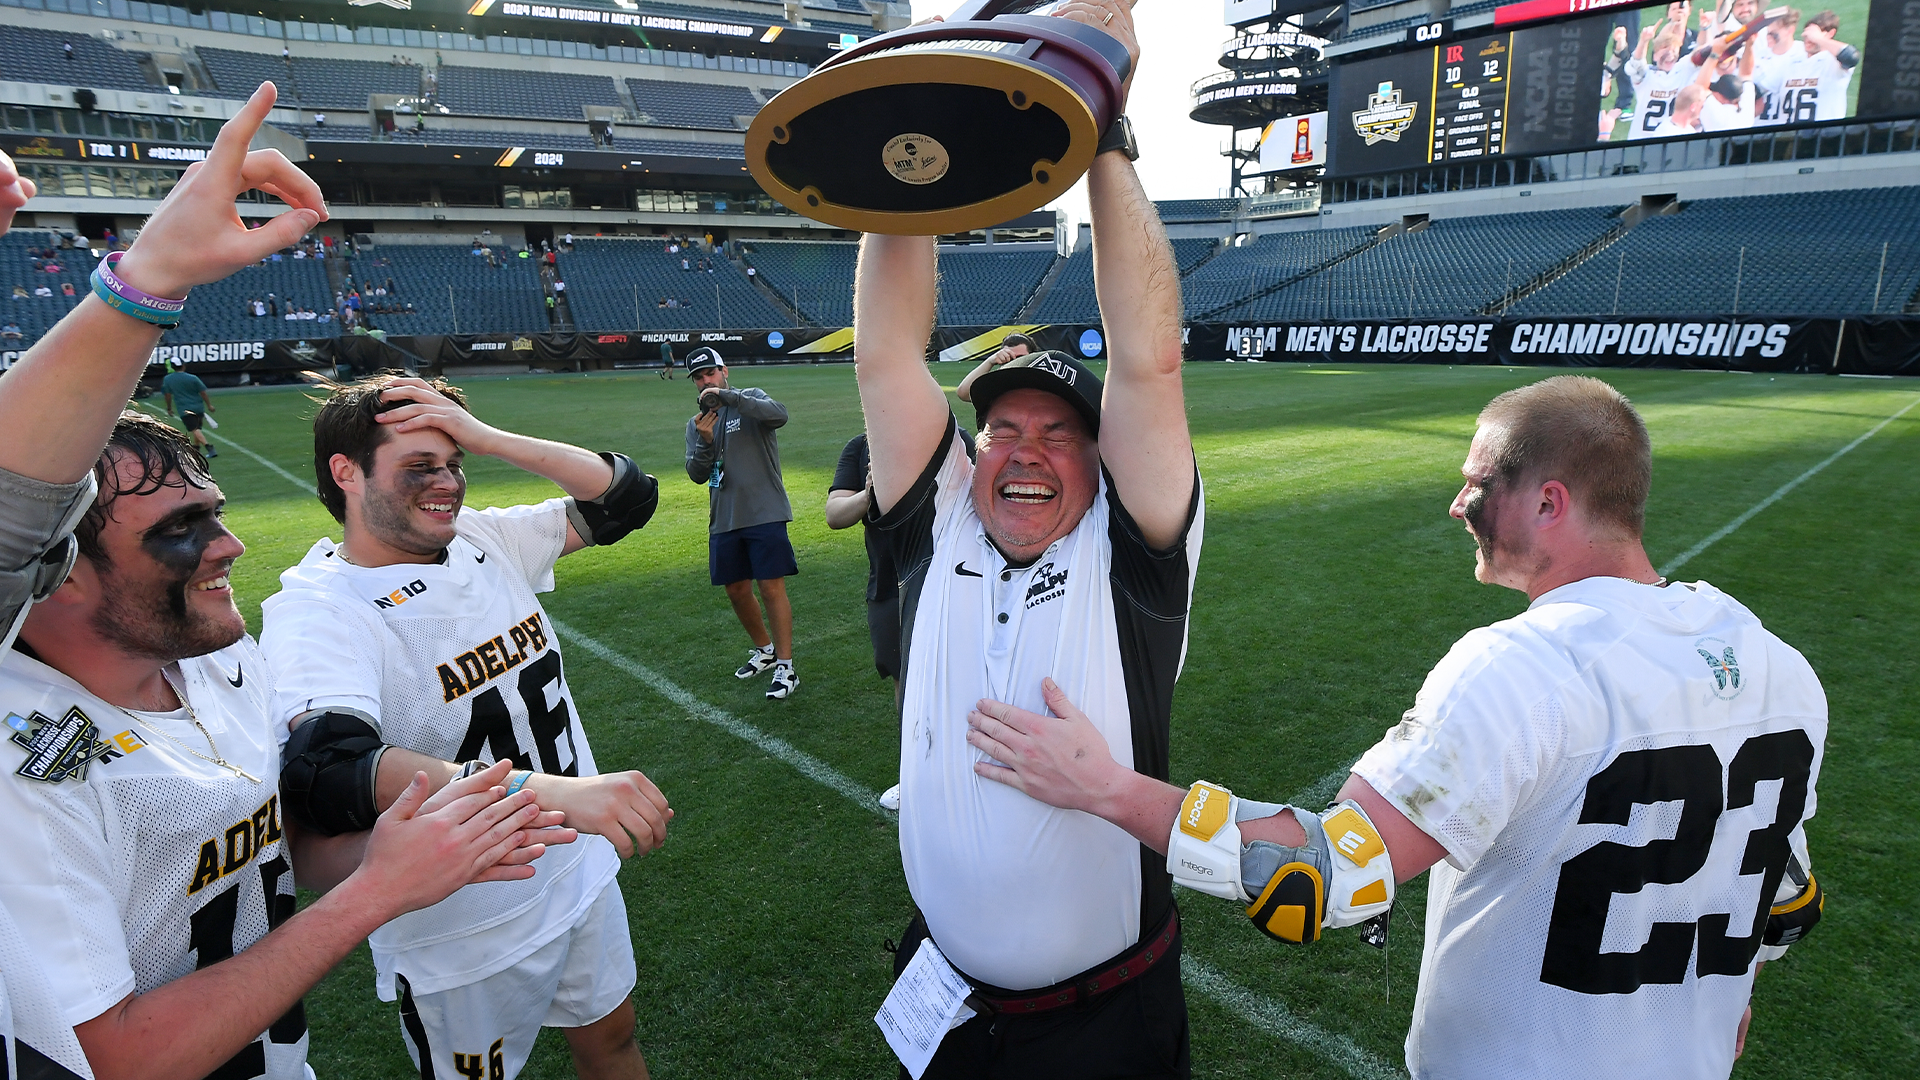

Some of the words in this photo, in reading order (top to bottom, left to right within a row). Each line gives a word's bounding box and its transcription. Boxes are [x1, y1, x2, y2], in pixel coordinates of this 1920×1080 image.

[531, 5, 557, 18] NCAA
[559, 8, 600, 22] DIVISION
[602, 12, 610, 23] II
[611, 13, 640, 26] MEN'S
[642, 16, 687, 31] LACROSSE
[688, 20, 753, 37] CHAMPIONSHIP
[1246, 33, 1296, 47] LACROSSE
[1416, 22, 1442, 42] 0.0
[1446, 67, 1461, 83] 10
[1483, 60, 1499, 76] 12
[1524, 48, 1552, 133] NCAA
[1552, 26, 1581, 140] LACROSSE
[1215, 88, 1234, 100] NCAA
[1236, 85, 1263, 97] MEN'S
[1462, 86, 1479, 98] 0.0
[1458, 100, 1481, 110] FINAL
[1782, 88, 1818, 124] 46
[535, 153, 563, 166] 2024
[598, 335, 627, 343] ESPN
[642, 333, 690, 343] #NCAAMLAX
[701, 332, 743, 342] NCAA.com
[1285, 326, 1355, 352] MEN'S
[1361, 323, 1493, 352] LACROSSE
[1510, 323, 1791, 357] CHAMPIONSHIPS
[472, 343, 496, 351] HOSTED
[498, 342, 506, 350] BY
[1082, 342, 1102, 351] NCAA
[374, 579, 427, 609] NE10
[30, 716, 84, 776] CHAMPIONSHIPS
[34, 725, 61, 754] LACROSSE
[1188, 788, 1210, 828] EPOCH
[1181, 858, 1213, 876] Integra
[1540, 729, 1815, 995] 23
